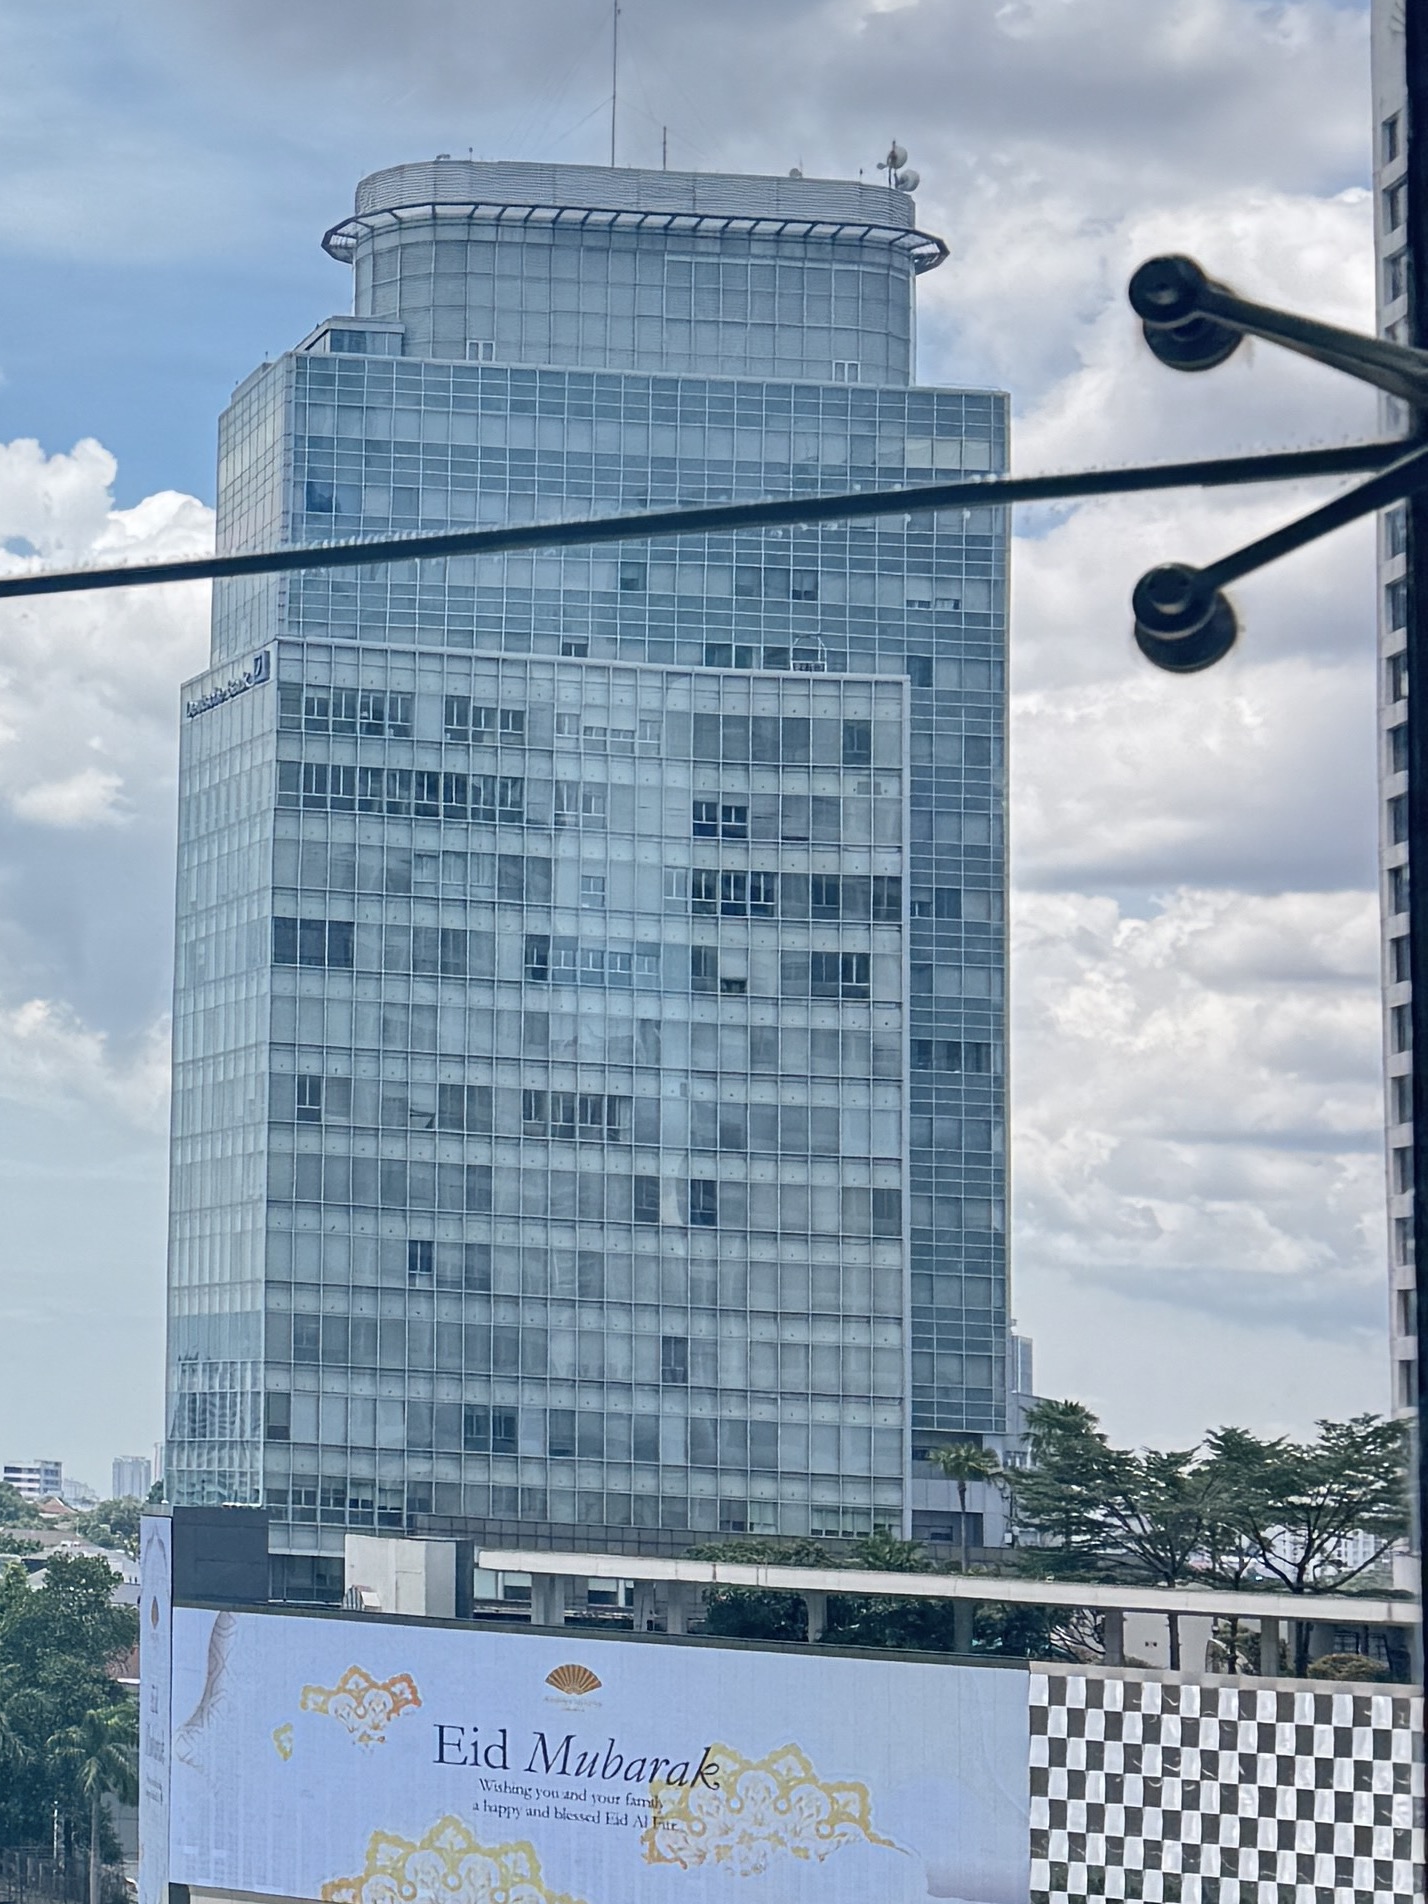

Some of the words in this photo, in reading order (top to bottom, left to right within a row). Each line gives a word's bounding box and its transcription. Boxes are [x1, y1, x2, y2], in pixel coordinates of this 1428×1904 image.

[433, 1723, 510, 1771] Eid
[523, 1731, 721, 1790] Mubarak
[479, 1778, 532, 1800] Wishing
[535, 1788, 559, 1800] you
[562, 1789, 587, 1802] and
[591, 1793, 620, 1807] your
[483, 1799, 521, 1820] happy
[526, 1805, 550, 1819] and
[554, 1806, 600, 1824] blessed
[606, 1811, 628, 1826] Eid
[633, 1814, 648, 1828] Al
